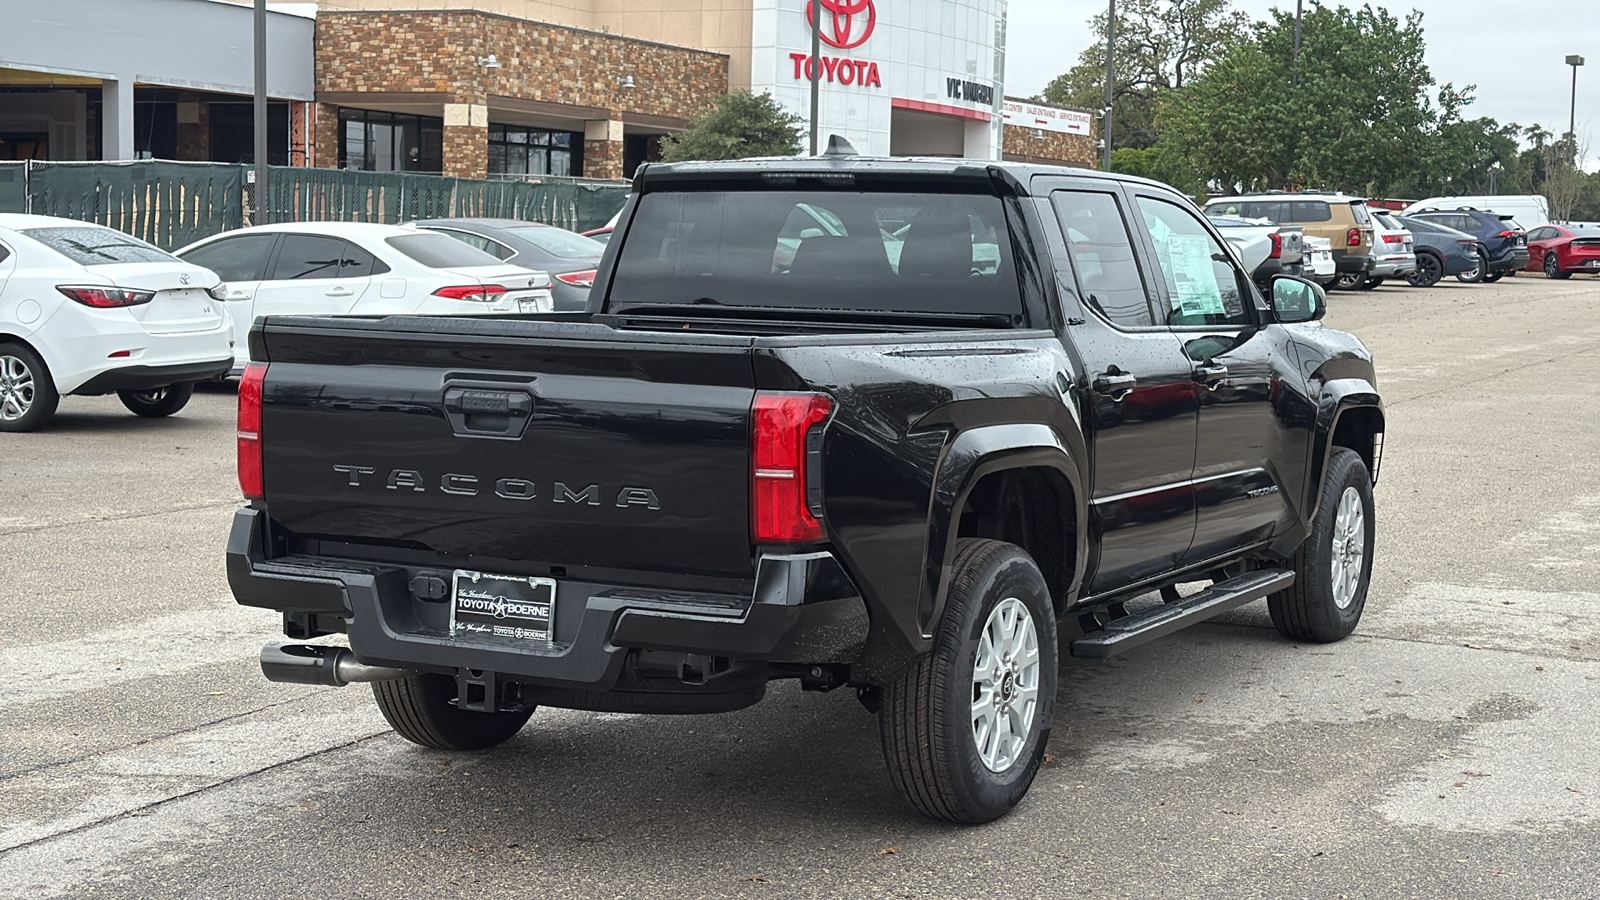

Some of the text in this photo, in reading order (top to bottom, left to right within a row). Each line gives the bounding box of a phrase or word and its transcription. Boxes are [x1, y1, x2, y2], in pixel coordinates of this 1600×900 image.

[789, 53, 881, 88] TOYOTA
[947, 77, 961, 99] VIC
[1009, 104, 1023, 113] CENTER
[1027, 106, 1056, 118] SALES ENTRANCE
[1060, 112, 1090, 123] SERVICE ENTRANCE
[464, 396, 509, 411] TOYOTA
[333, 464, 661, 510] TACOMA
[1247, 485, 1278, 498] TACOMA
[458, 598, 550, 617] TOYOTA BOERNE
[493, 627, 514, 635] TOYOTA
